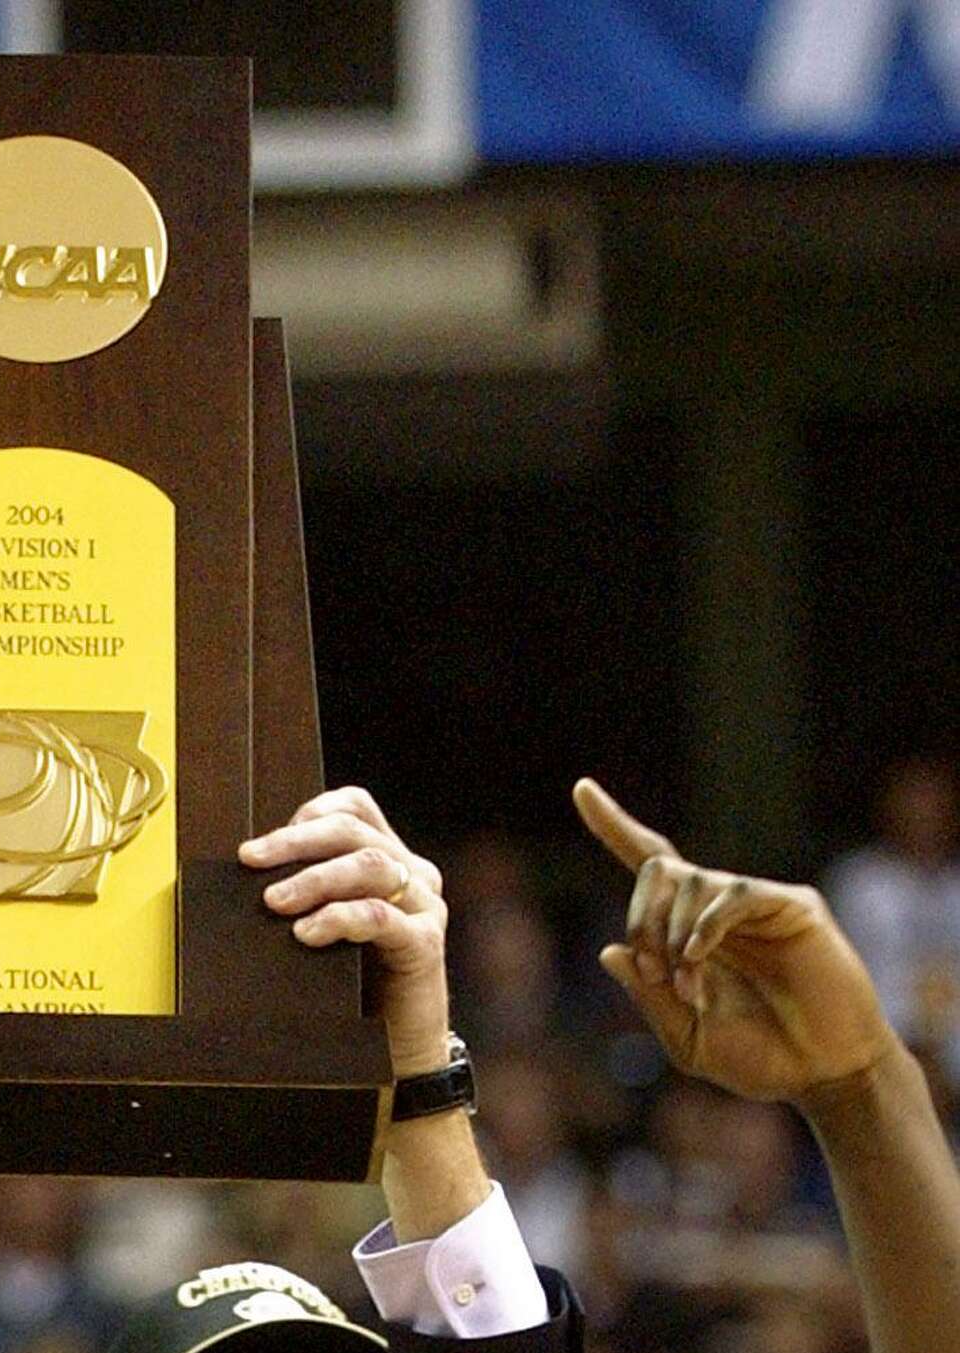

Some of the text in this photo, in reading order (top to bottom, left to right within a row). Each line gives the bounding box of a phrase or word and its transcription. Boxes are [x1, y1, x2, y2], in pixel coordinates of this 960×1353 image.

[5, 505, 66, 526] 2004
[88, 539, 96, 559] I
[0, 570, 72, 591] MEN'S
